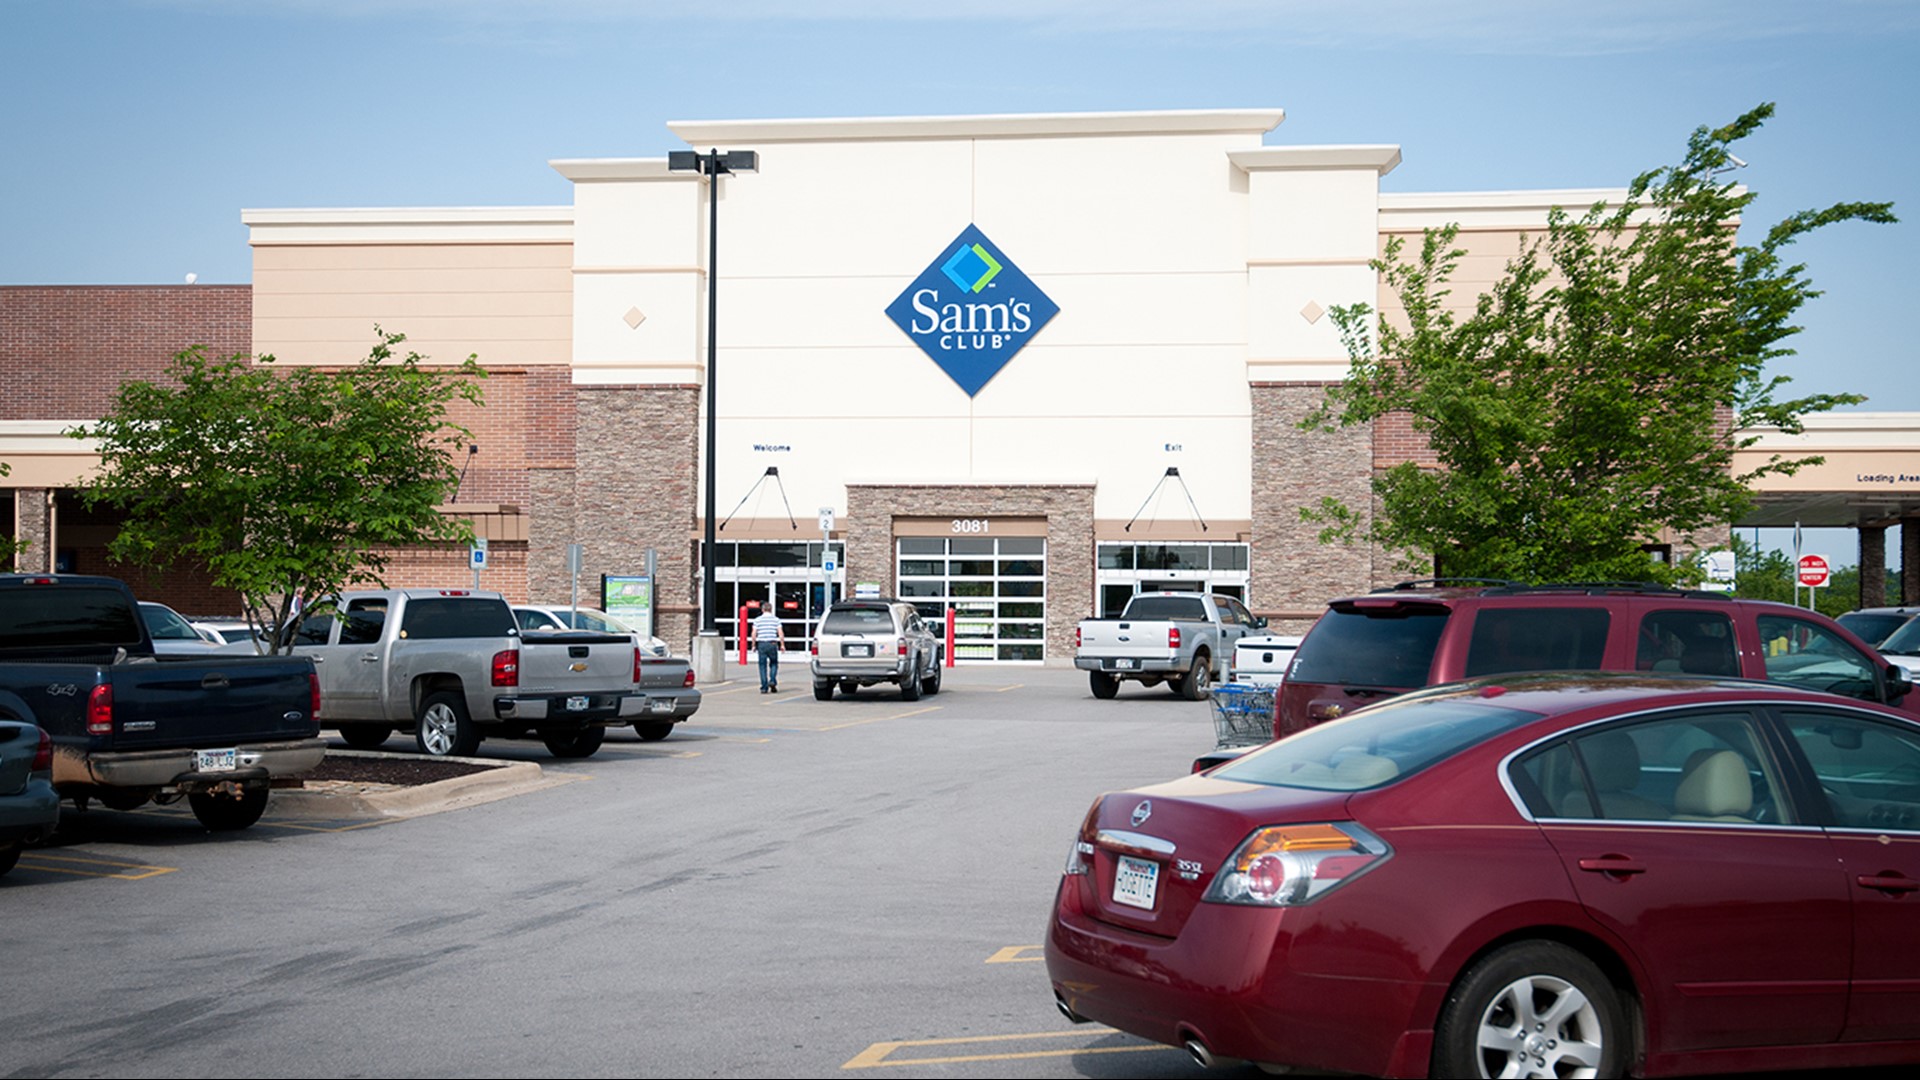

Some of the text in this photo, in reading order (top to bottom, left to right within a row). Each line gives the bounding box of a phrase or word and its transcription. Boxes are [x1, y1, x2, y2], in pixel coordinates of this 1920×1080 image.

[911, 289, 1031, 334] Sam's
[940, 335, 1003, 350] CLUB
[753, 444, 791, 452] Welcome
[1165, 443, 1182, 452] Exit
[1857, 474, 1895, 484] Loading
[823, 519, 829, 529] 2
[951, 519, 989, 533] 3081
